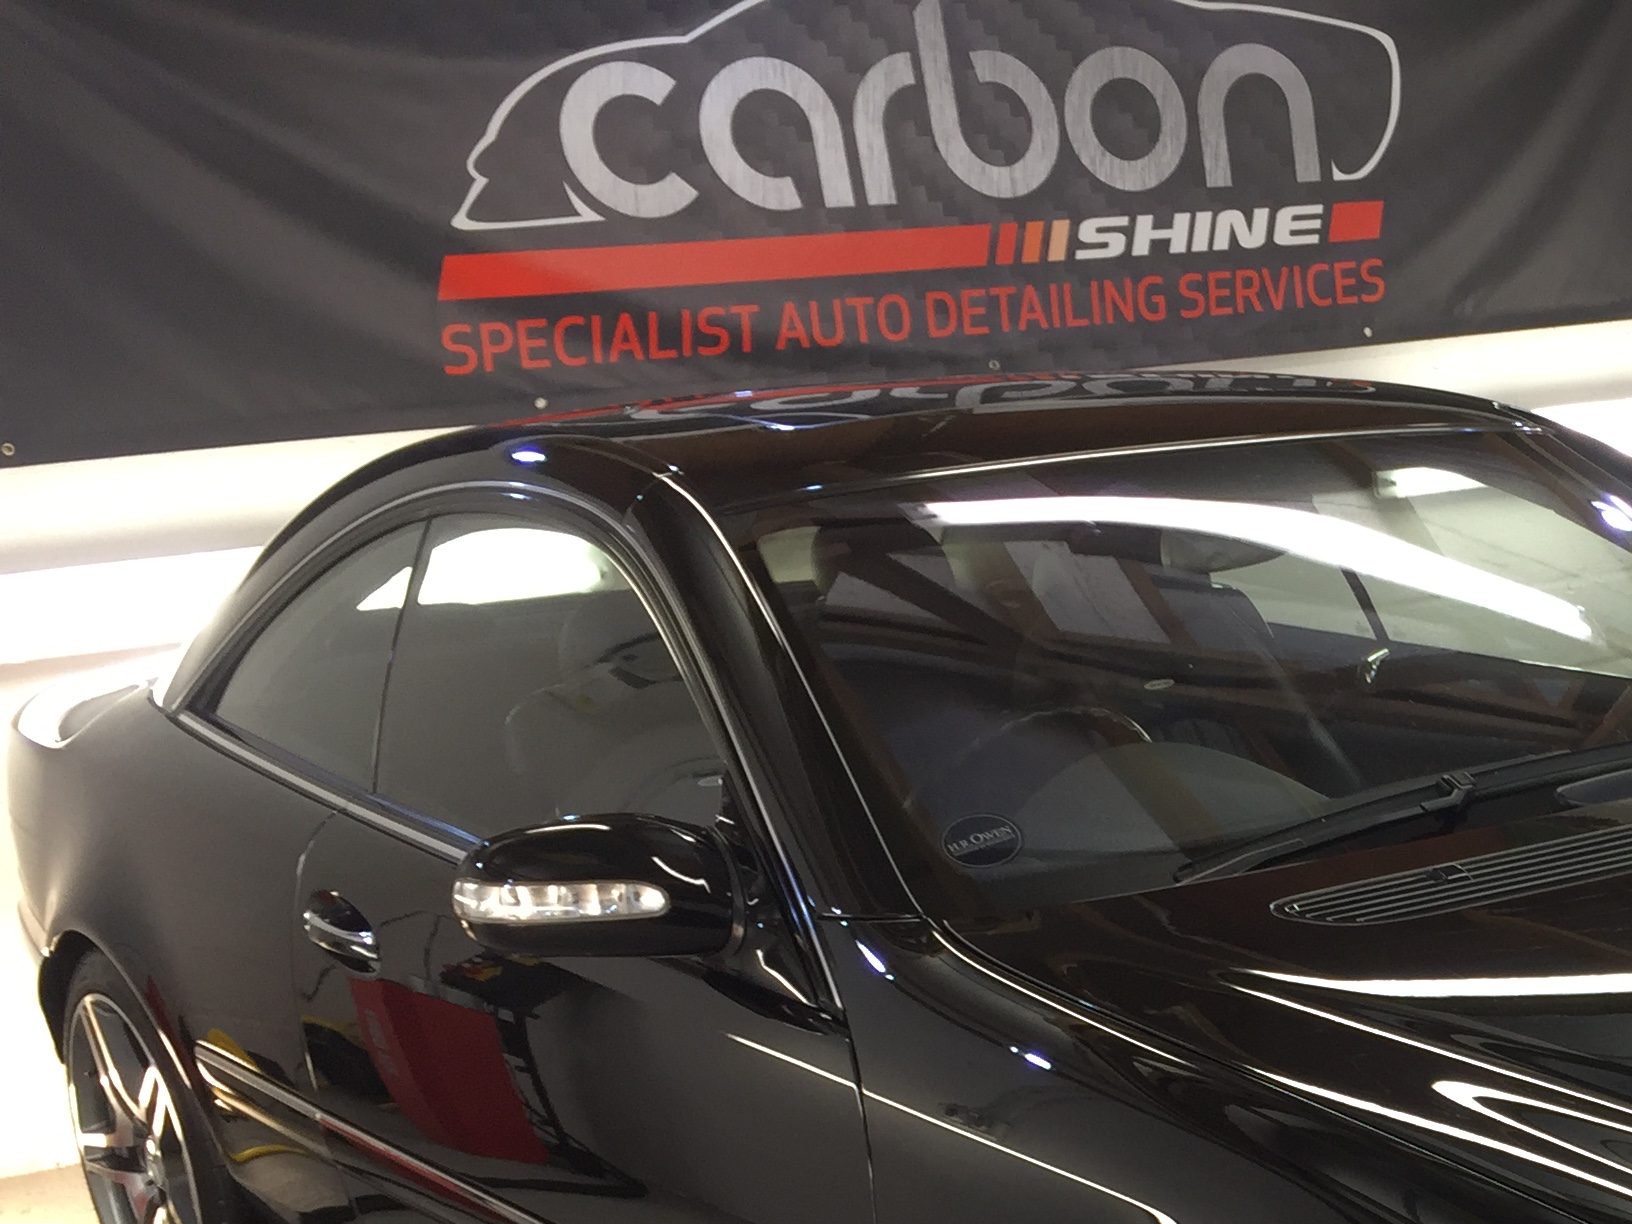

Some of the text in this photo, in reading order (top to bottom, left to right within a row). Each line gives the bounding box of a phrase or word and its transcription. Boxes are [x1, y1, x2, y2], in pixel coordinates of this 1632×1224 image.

[559, 0, 1321, 218] carbon
[1074, 203, 1324, 260] SHINE
[440, 258, 1386, 376] SPECIALIST AUTO DETAILING SERVICES
